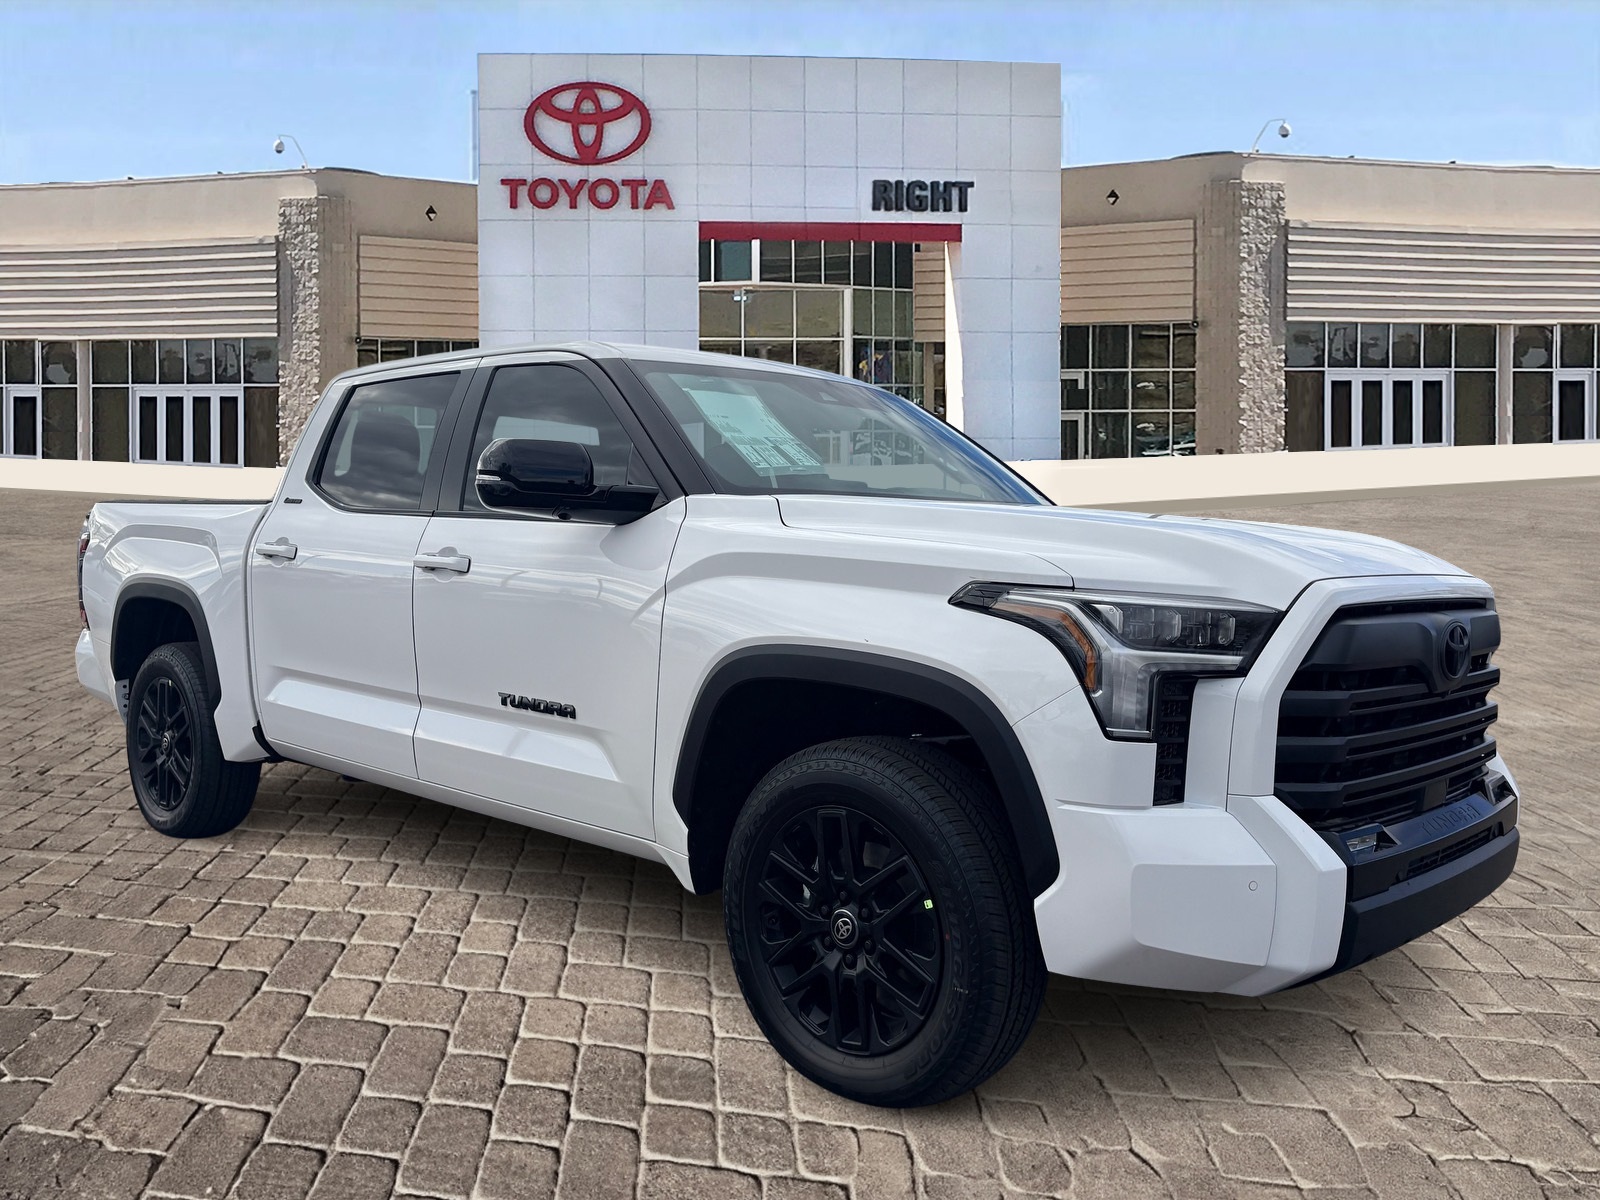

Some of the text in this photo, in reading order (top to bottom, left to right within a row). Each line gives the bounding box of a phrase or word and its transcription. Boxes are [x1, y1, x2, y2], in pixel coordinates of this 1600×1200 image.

[501, 178, 675, 210] TOYOTA
[872, 180, 975, 212] RIGHT
[498, 692, 577, 719] TUNDRA
[1420, 803, 1481, 836] TUNDRA
